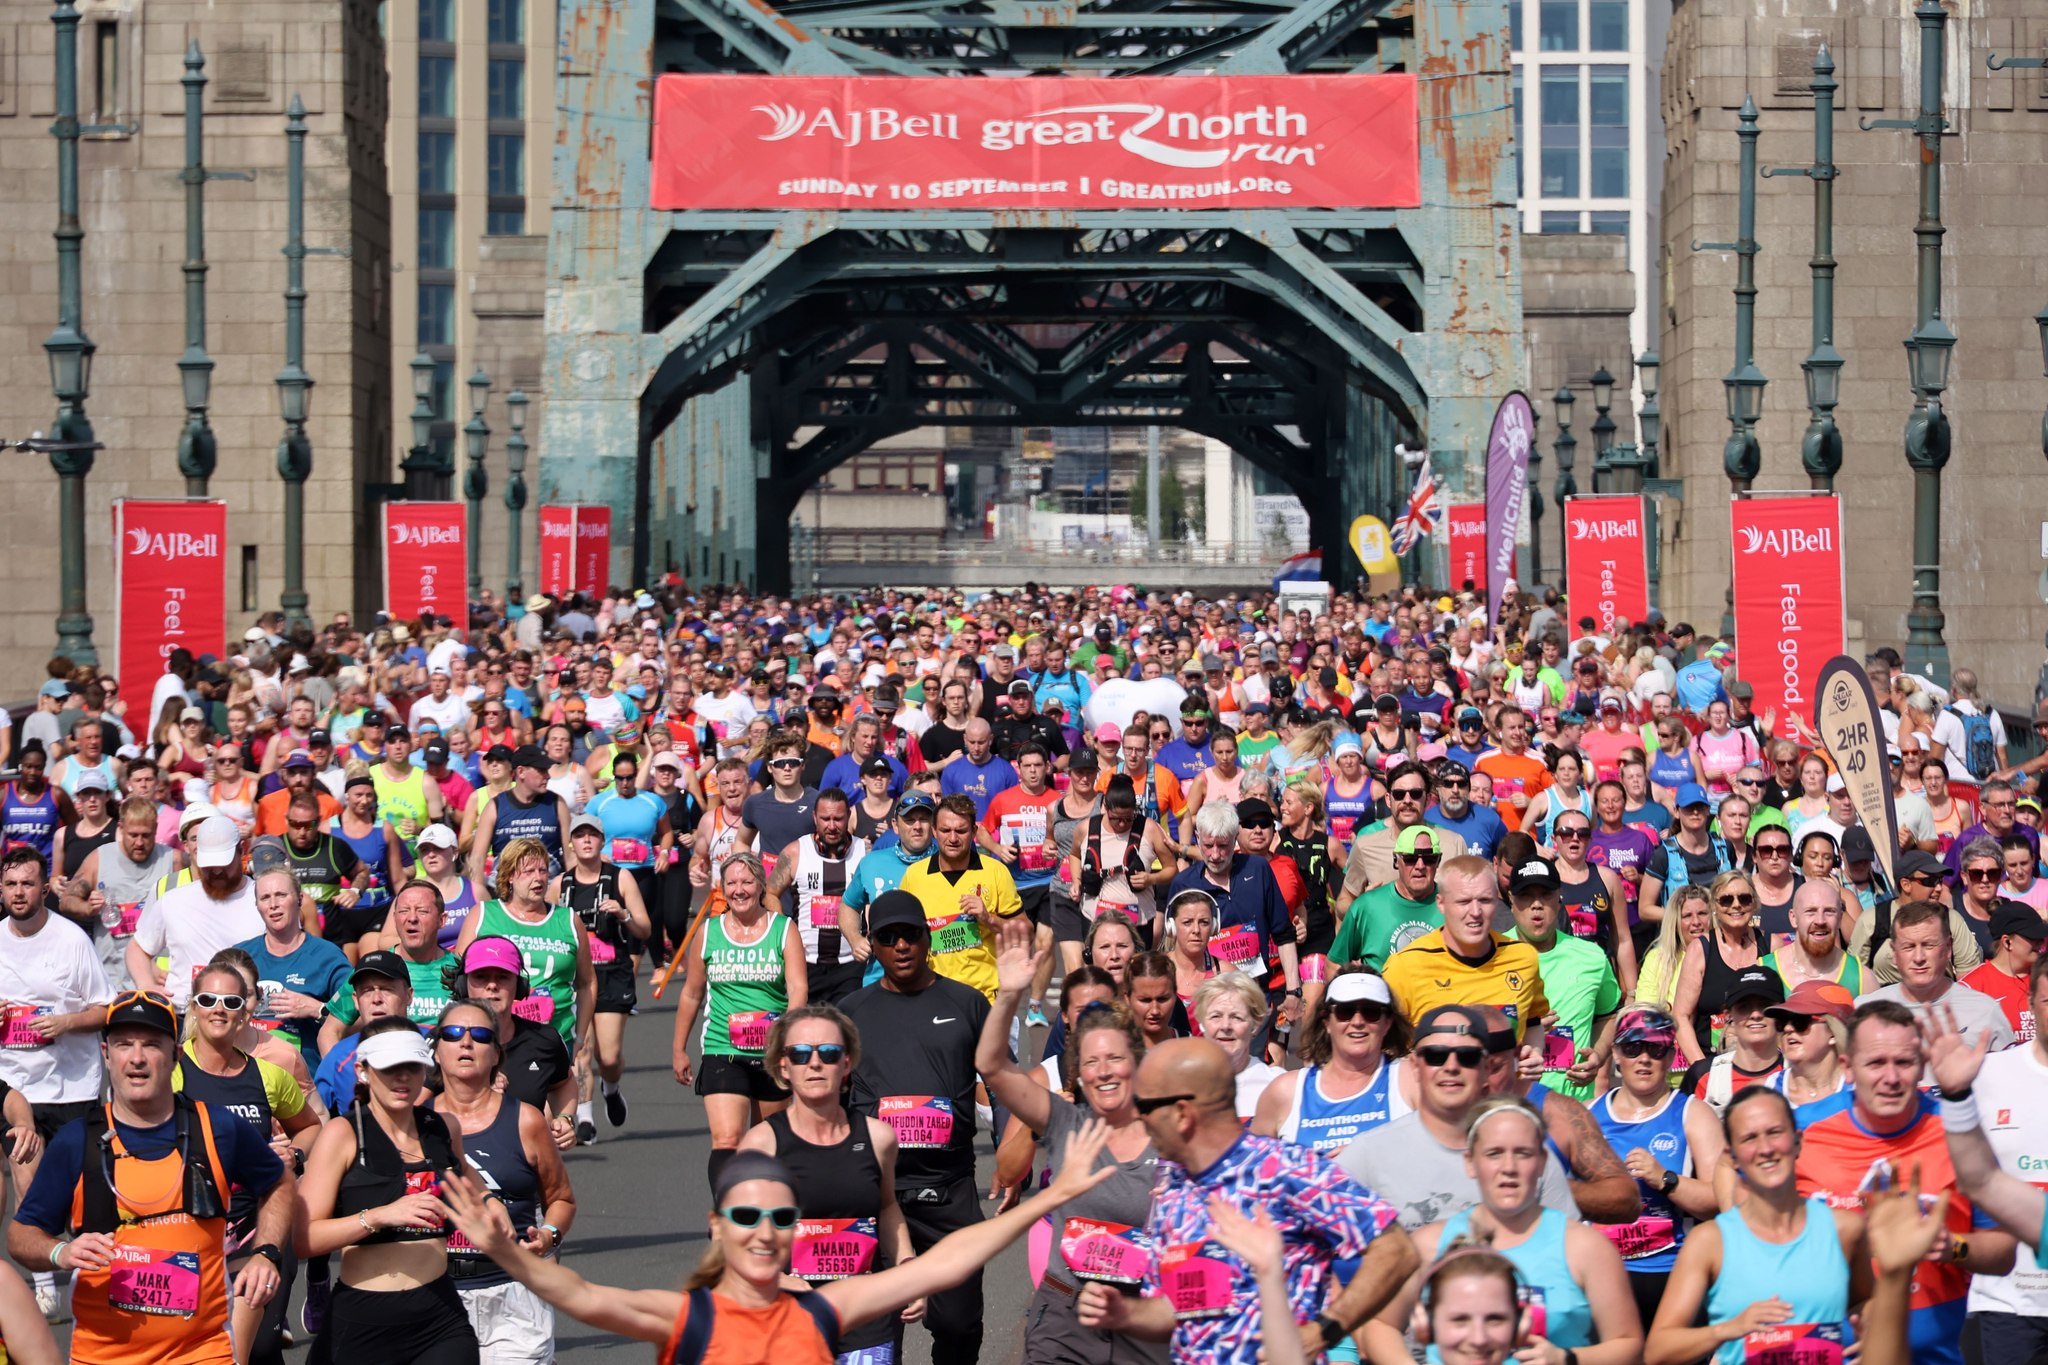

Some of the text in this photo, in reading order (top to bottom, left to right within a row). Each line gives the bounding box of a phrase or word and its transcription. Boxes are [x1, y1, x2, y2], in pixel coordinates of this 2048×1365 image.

[981, 105, 1307, 150] great north
[1231, 143, 1316, 166] run
[778, 178, 878, 199] SUNDAY
[889, 183, 921, 199] 10
[928, 177, 1068, 199] SEPTEMBER
[1100, 177, 1293, 199] GREATRUN.ORG
[1763, 527, 1832, 558] AJBell
[420, 565, 438, 601] Feel
[1599, 560, 1616, 632] Feel goo
[165, 587, 186, 635] Feel
[1779, 583, 1801, 635] Feel
[1837, 721, 1869, 751] 2HR
[1846, 749, 1866, 774] 40
[511, 817, 542, 826] FRIENDS
[807, 872, 819, 880] NU
[939, 928, 966, 939] JOSHUA
[1390, 920, 1434, 943] BERLIN-MARAT
[712, 949, 777, 962] NICHOLA
[708, 962, 781, 975] MACMILLAN
[743, 973, 778, 982] SUPPORT
[418, 1007, 441, 1016] SUPP
[742, 1026, 766, 1035] NICHOL
[889, 1100, 913, 1110] AJBell
[1301, 1110, 1386, 1128] SCUNTHORPE
[900, 1129, 932, 1142] 51064
[1326, 1125, 1358, 1136] AND
[803, 1225, 833, 1236] AJBell
[1617, 1224, 1649, 1241] JAYNE
[812, 1241, 860, 1257] AMANDA
[1086, 1241, 1124, 1258] SARAH
[121, 1251, 151, 1264] AJBell
[817, 1258, 856, 1273] 55636
[136, 1271, 172, 1290] MARK
[131, 1288, 173, 1307] 52417
[118, 1302, 163, 1313] GOODMOVE
